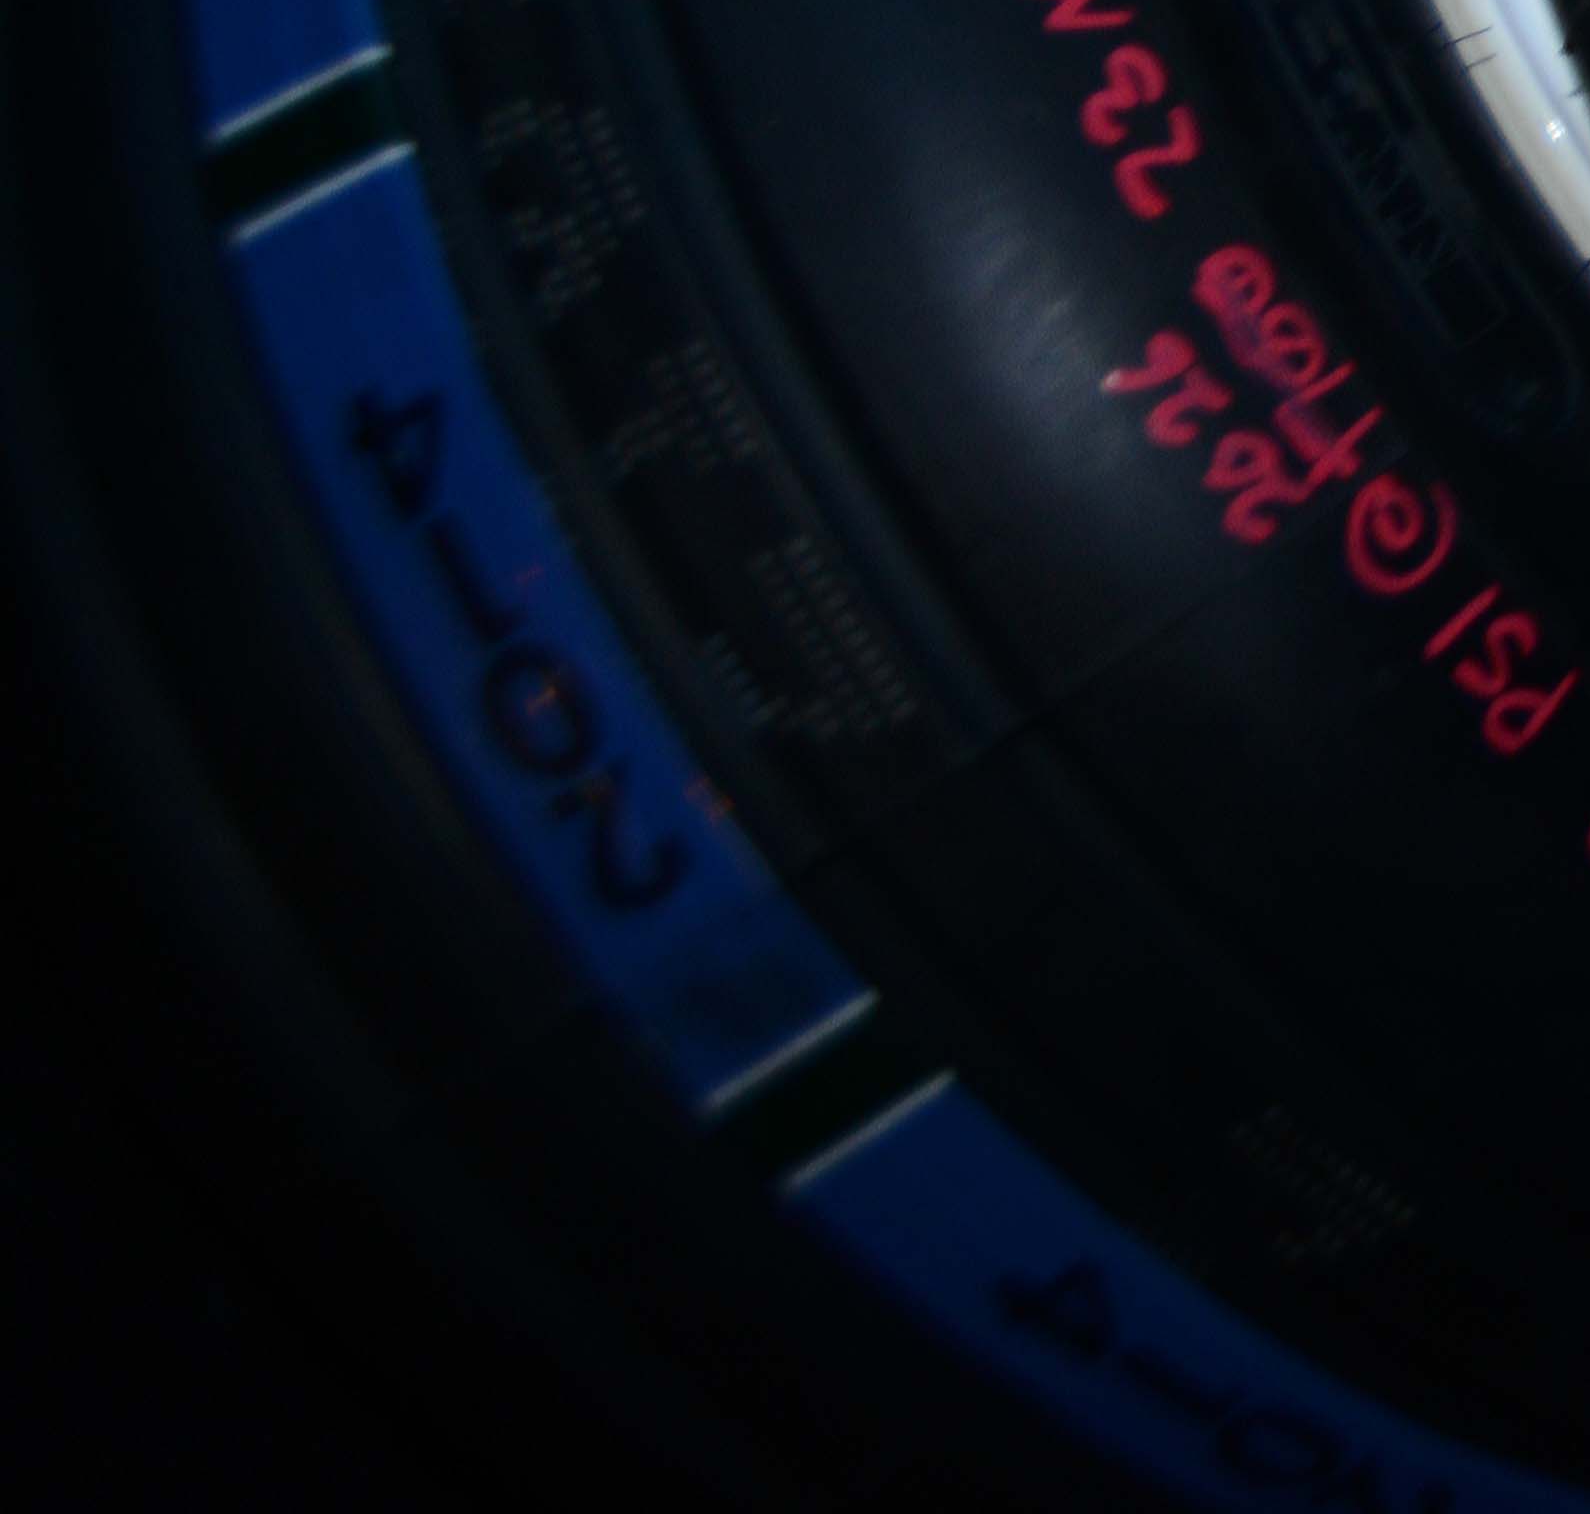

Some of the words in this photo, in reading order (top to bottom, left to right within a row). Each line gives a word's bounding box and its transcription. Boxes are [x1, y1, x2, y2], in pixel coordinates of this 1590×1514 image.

[1079, 39, 1204, 221] 23
[1102, 324, 1310, 547] 2026
[1341, 474, 1463, 601] @
[347, 383, 690, 910] 2014
[1423, 583, 1582, 759] PSI
